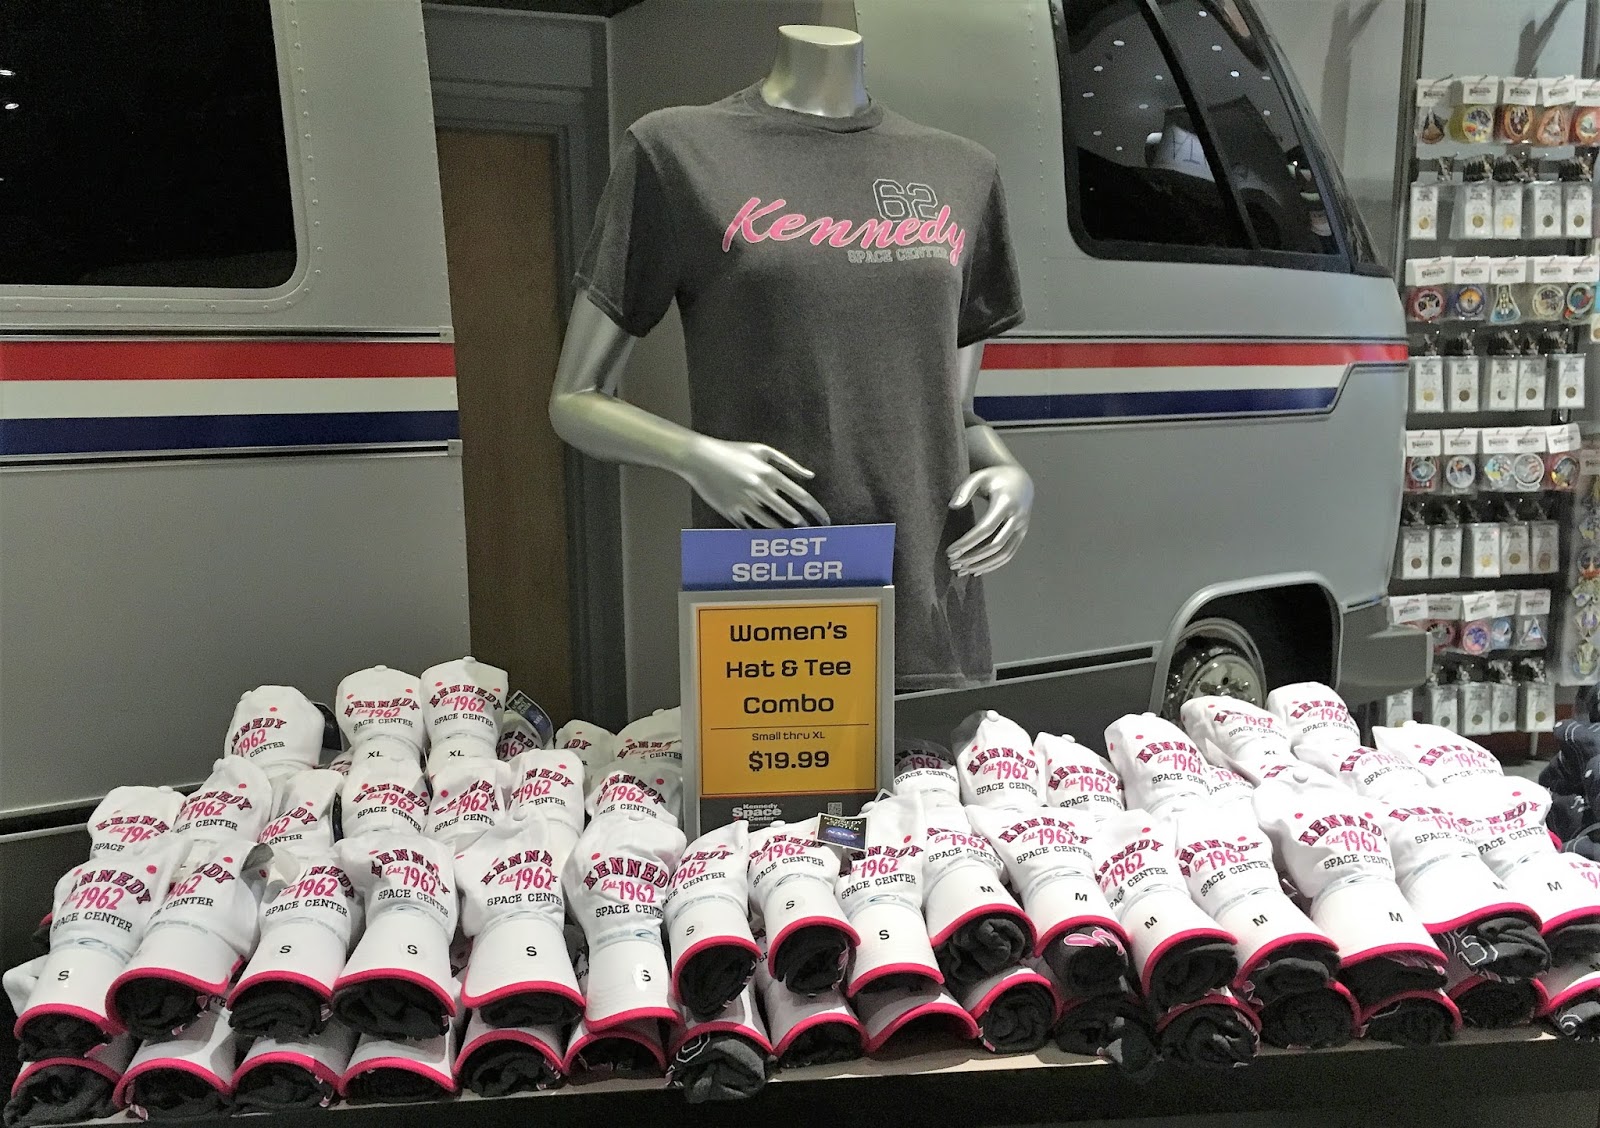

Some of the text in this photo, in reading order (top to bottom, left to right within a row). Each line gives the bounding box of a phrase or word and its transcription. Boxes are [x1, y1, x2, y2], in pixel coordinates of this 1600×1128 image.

[872, 179, 938, 222] 62
[722, 197, 965, 266] Kennedy
[847, 245, 949, 264] SPACE CENTER
[751, 537, 827, 557] BEST
[732, 561, 843, 582] SELLER
[730, 622, 848, 642] Women's
[726, 659, 851, 678] Hat & Tee
[429, 685, 502, 710] KENNEDY
[453, 696, 486, 712] 1962
[743, 694, 834, 714] Combo
[344, 698, 420, 717] KENNEDY
[368, 708, 401, 719] 1962
[353, 718, 413, 733] SPACE CENTER
[434, 713, 494, 728] SPACE CENTER
[1302, 722, 1329, 734] SPACE
[237, 729, 267, 756] 1962
[752, 731, 825, 741] Small thru XL
[249, 741, 285, 758] CENTER
[501, 741, 524, 759] 962
[1136, 741, 1197, 763] KENNE
[748, 751, 830, 772] $19.99
[910, 757, 943, 769] 1962
[996, 761, 1029, 780] 1962
[895, 770, 922, 785] SPACE
[1078, 776, 1111, 793] 1962
[1152, 773, 1183, 784] SPACE
[517, 780, 551, 803] 1962
[611, 786, 645, 803] 1962
[976, 782, 1004, 796] SPACE
[187, 801, 227, 820] 1962
[381, 792, 415, 814] 1962
[456, 793, 488, 816] 1962
[620, 804, 657, 817] CENTER
[1060, 795, 1089, 808] SPACE
[357, 806, 422, 833] SPACE CENTER
[732, 807, 782, 818] Space
[96, 815, 170, 834] KENNE
[195, 819, 238, 831] CENTER
[434, 813, 496, 833] SPACE CENTE
[1298, 814, 1382, 846] KENNED
[121, 826, 159, 843] 196
[950, 834, 986, 850] 1962
[1037, 828, 1075, 845] 1962
[1342, 830, 1382, 853] 1962
[1415, 832, 1452, 845] SPACE
[1477, 837, 1506, 855] PACE
[1509, 826, 1546, 840] CENTE
[94, 842, 125, 852] SPACE
[767, 844, 805, 861] 1962
[929, 847, 962, 862] SPACE
[1016, 845, 1092, 864] SPACE CENTER
[481, 850, 553, 885] KENNE
[860, 858, 899, 878] 1962
[1095, 840, 1164, 885] ENNEDY
[1110, 853, 1145, 886] 1962
[1206, 850, 1249, 871] 1962
[1323, 854, 1360, 870] SPACE
[371, 850, 450, 895] KENNEY
[514, 866, 553, 891] 1962
[583, 857, 669, 890] KENNED
[671, 861, 706, 888] 1962
[682, 872, 726, 889] CENTER
[753, 856, 824, 887] SPACE CENTER
[294, 877, 338, 899] 1962
[402, 866, 437, 896] 1962
[841, 874, 916, 899] SPACE CENTER
[980, 885, 994, 893] M
[1109, 867, 1168, 910] PACE CENTER
[1200, 871, 1226, 897] SPACE
[1547, 881, 1562, 892] M
[75, 887, 124, 910] 1962
[487, 893, 522, 906] SPACE
[618, 880, 656, 903] 1962
[1075, 893, 1088, 901] M
[166, 896, 214, 910] CENTER
[265, 899, 348, 917] SPACE CENTER
[378, 889, 449, 917] SPACE CENTER
[596, 904, 630, 918] SPACE
[786, 900, 795, 910] S
[84, 912, 133, 932] CENTER
[1144, 916, 1158, 929] M
[1252, 914, 1268, 927] M
[1388, 911, 1404, 923] M
[686, 926, 694, 935] S
[879, 930, 889, 940] S
[279, 945, 291, 954] S
[407, 945, 418, 955] S
[526, 946, 537, 956] S
[58, 970, 69, 980] S
